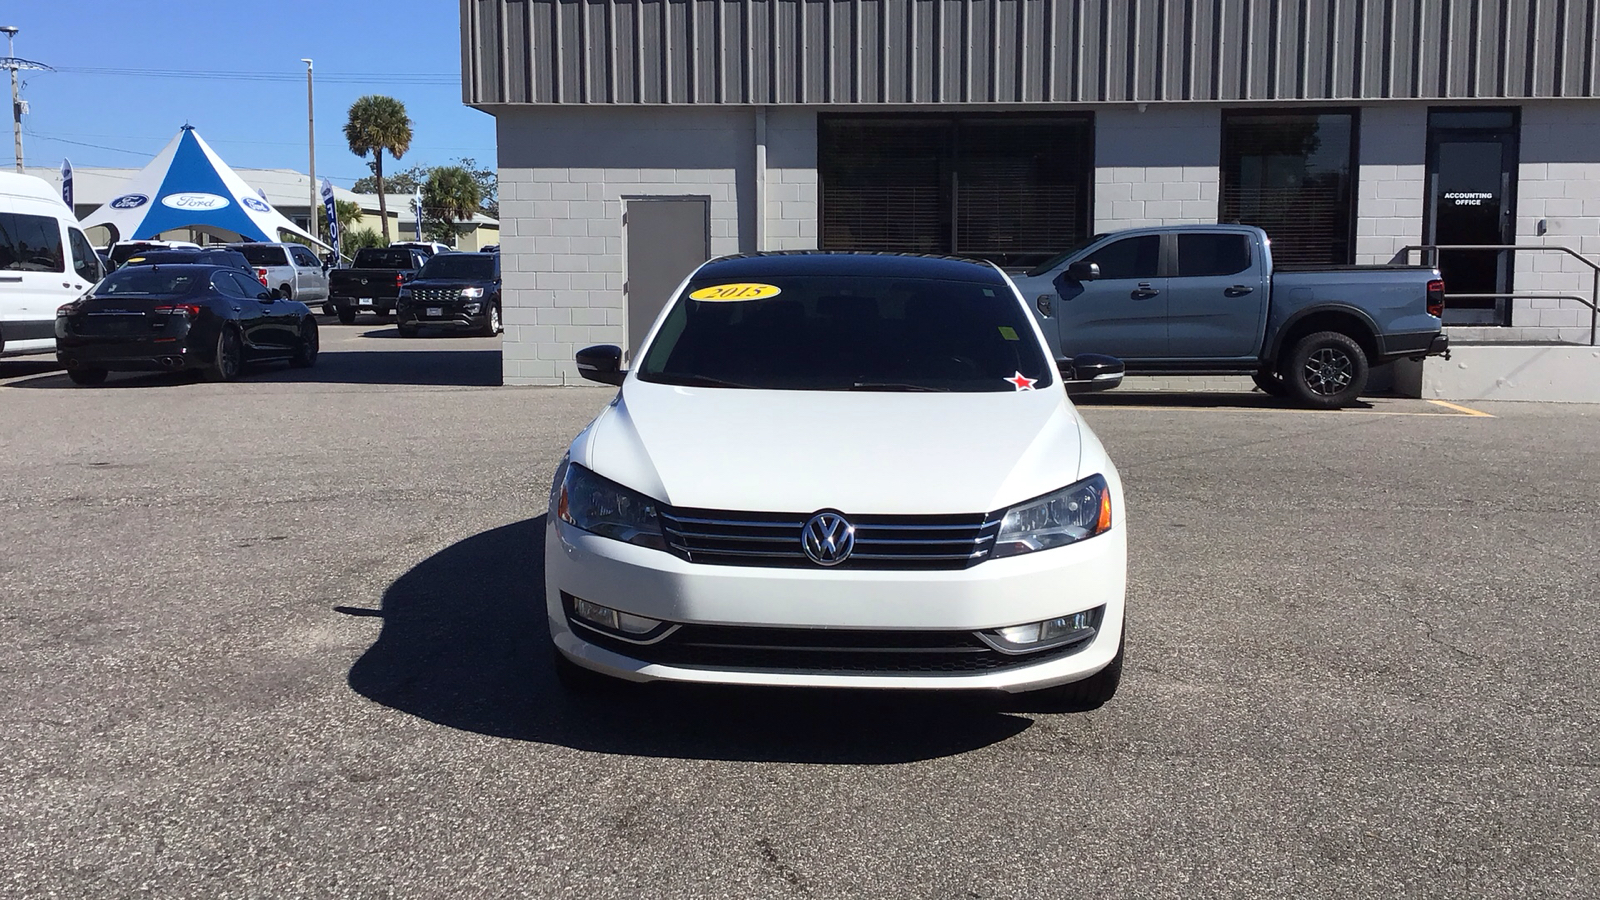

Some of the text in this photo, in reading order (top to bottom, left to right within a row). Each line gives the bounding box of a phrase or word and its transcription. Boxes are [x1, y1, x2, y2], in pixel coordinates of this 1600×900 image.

[115, 196, 143, 208] Ford
[176, 195, 216, 207] Ford
[704, 286, 767, 299] 2015
